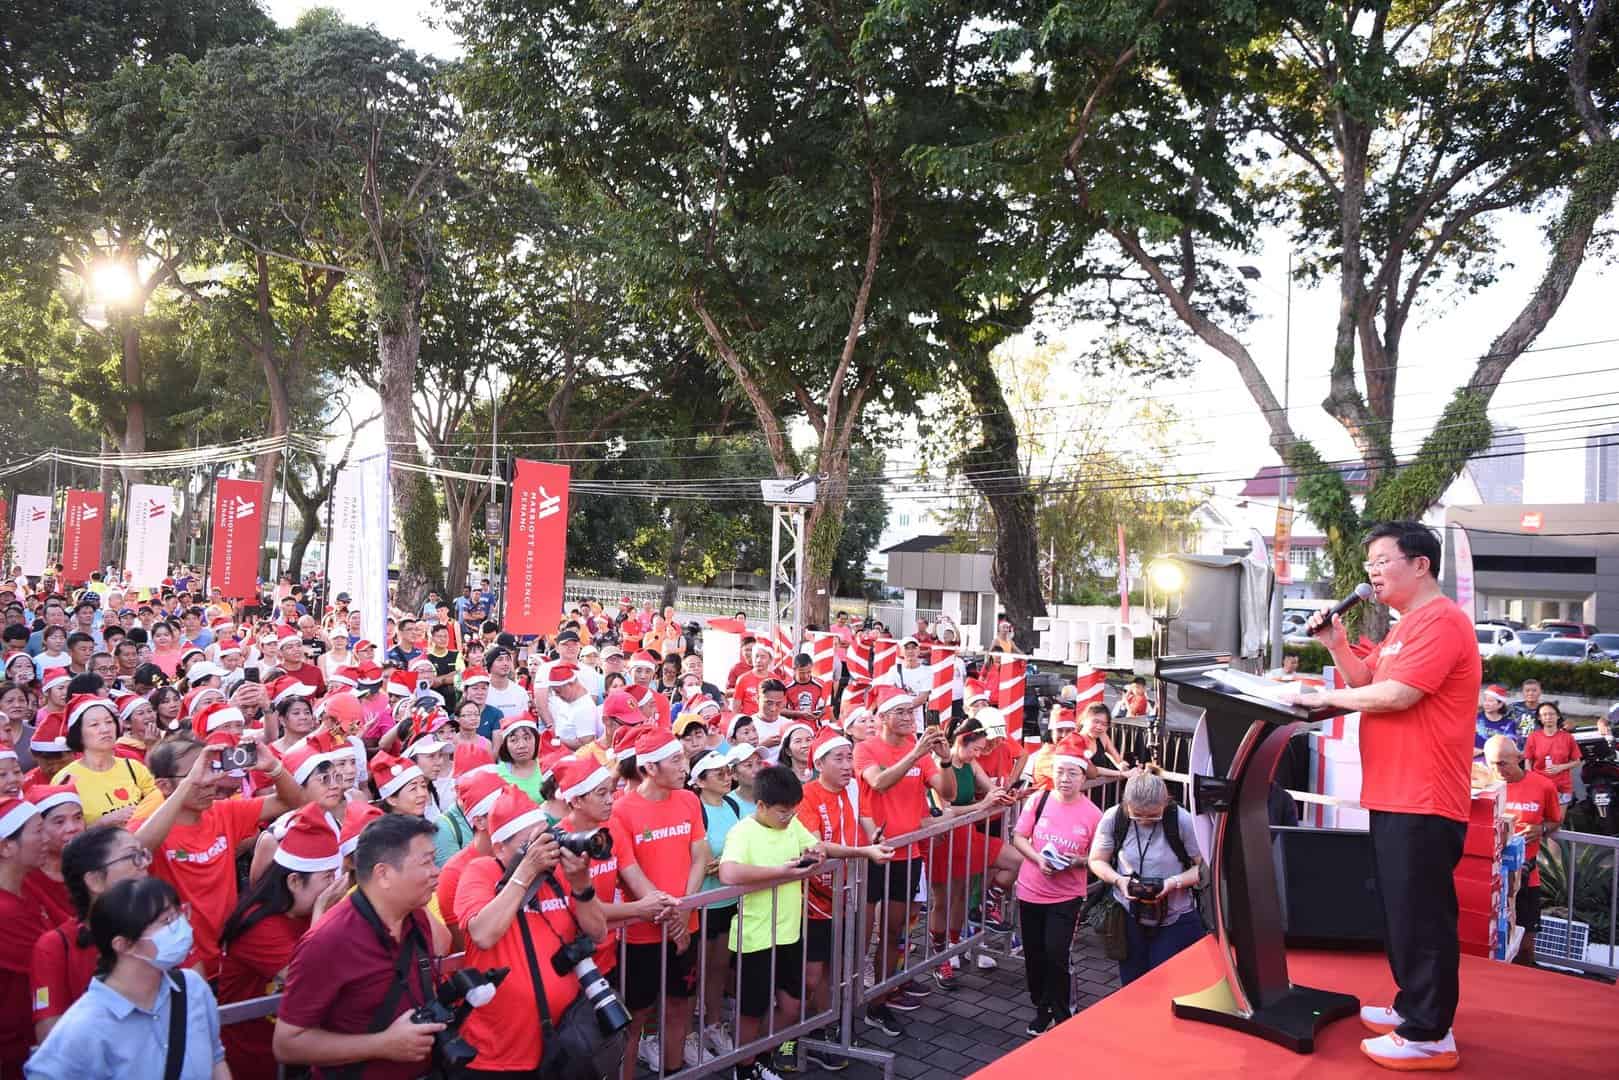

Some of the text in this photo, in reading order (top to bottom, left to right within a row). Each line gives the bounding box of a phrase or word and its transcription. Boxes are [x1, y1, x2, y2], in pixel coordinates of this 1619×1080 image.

[224, 499, 235, 585] MARRIOTT RESIDENCES
[519, 490, 528, 532] PENANG
[523, 492, 537, 616] MARRIOTT RESIDENCES
